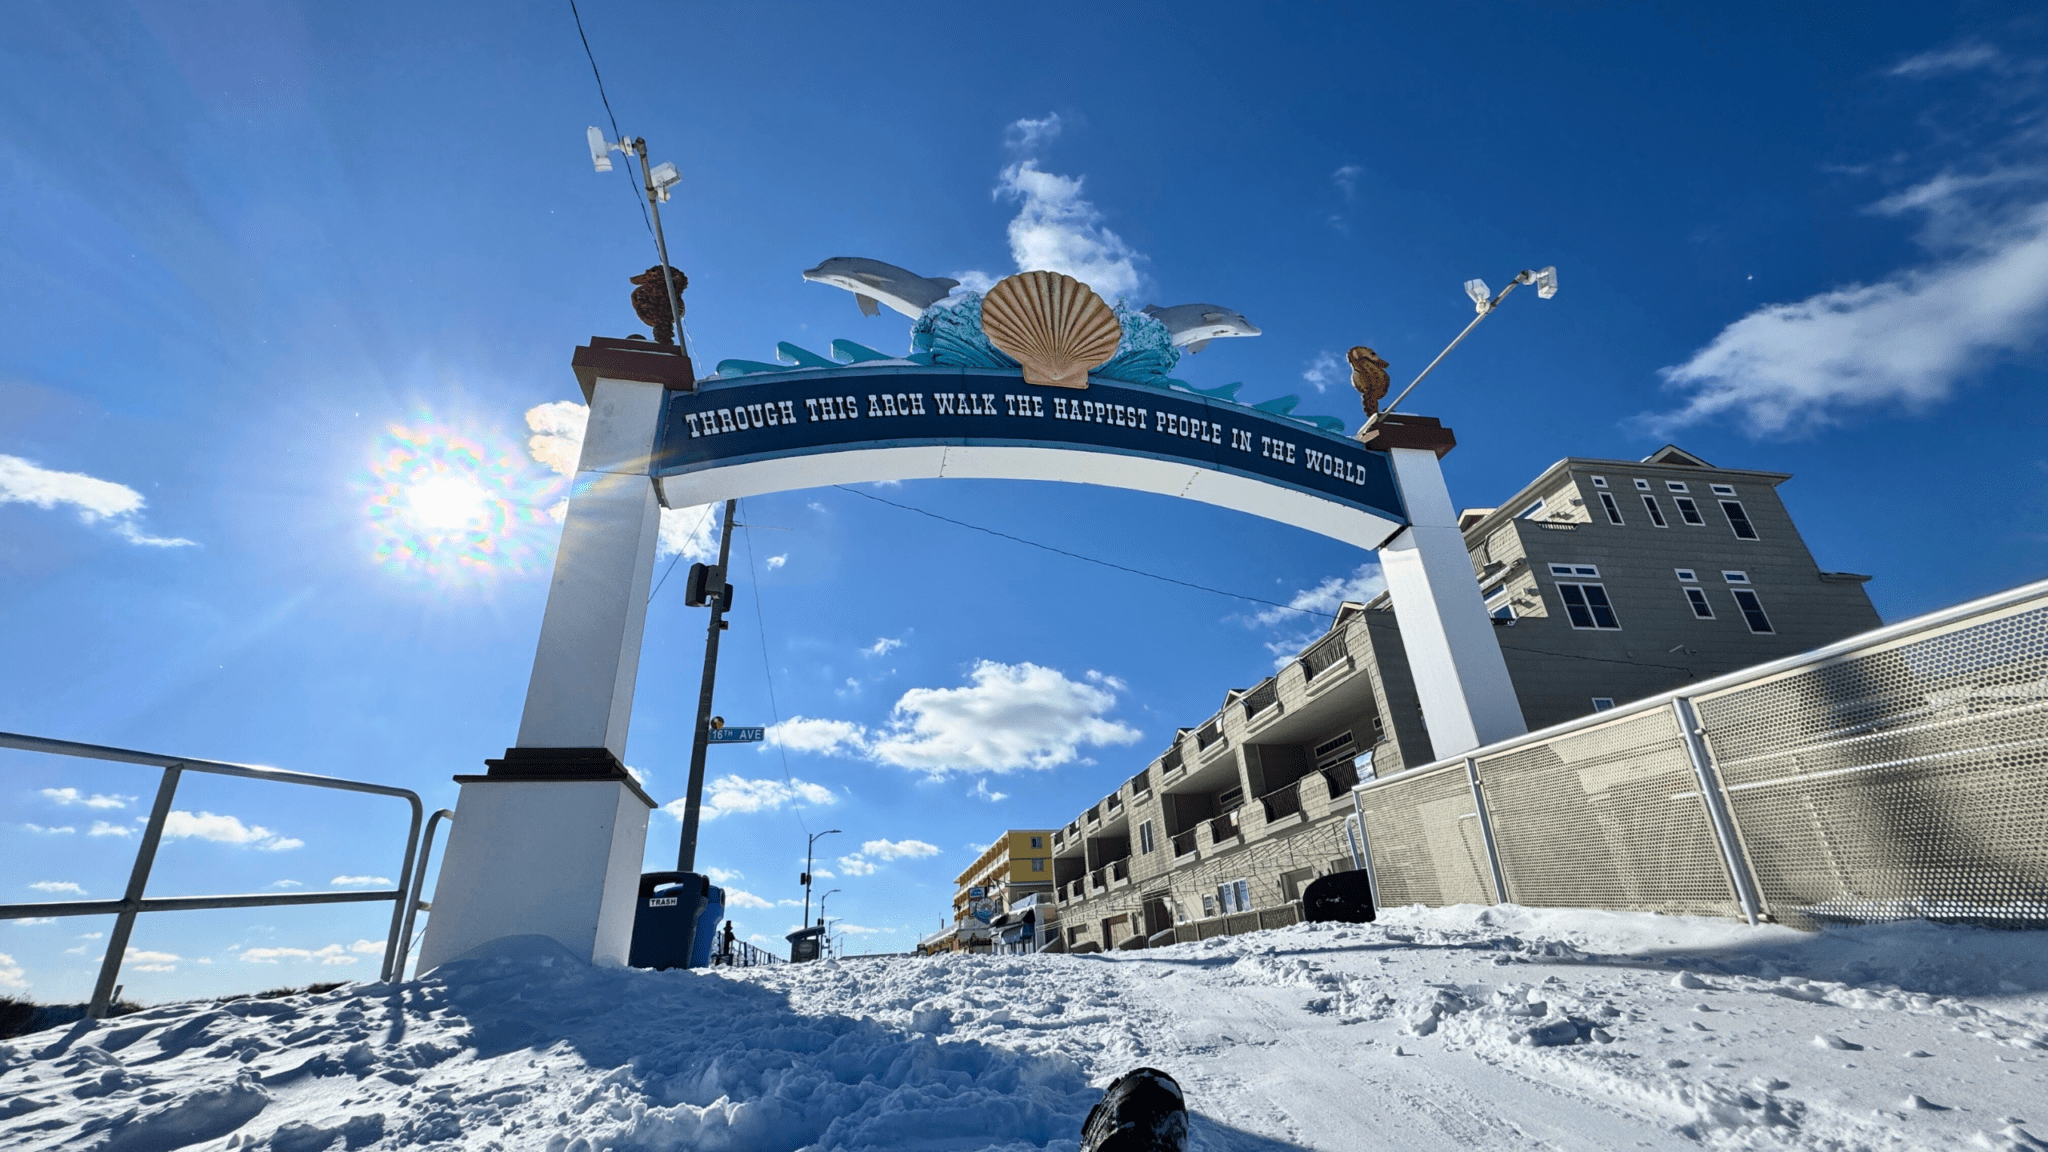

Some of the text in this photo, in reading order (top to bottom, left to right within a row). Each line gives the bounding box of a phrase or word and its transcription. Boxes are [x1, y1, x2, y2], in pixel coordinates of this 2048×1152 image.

[685, 393, 1366, 486] THROUGH THIS ARCH WALK THE HAPPIEST PEOPLE IN THE WORLD
[712, 729, 761, 740] 16TH AVE
[651, 898, 676, 906] TRASH
